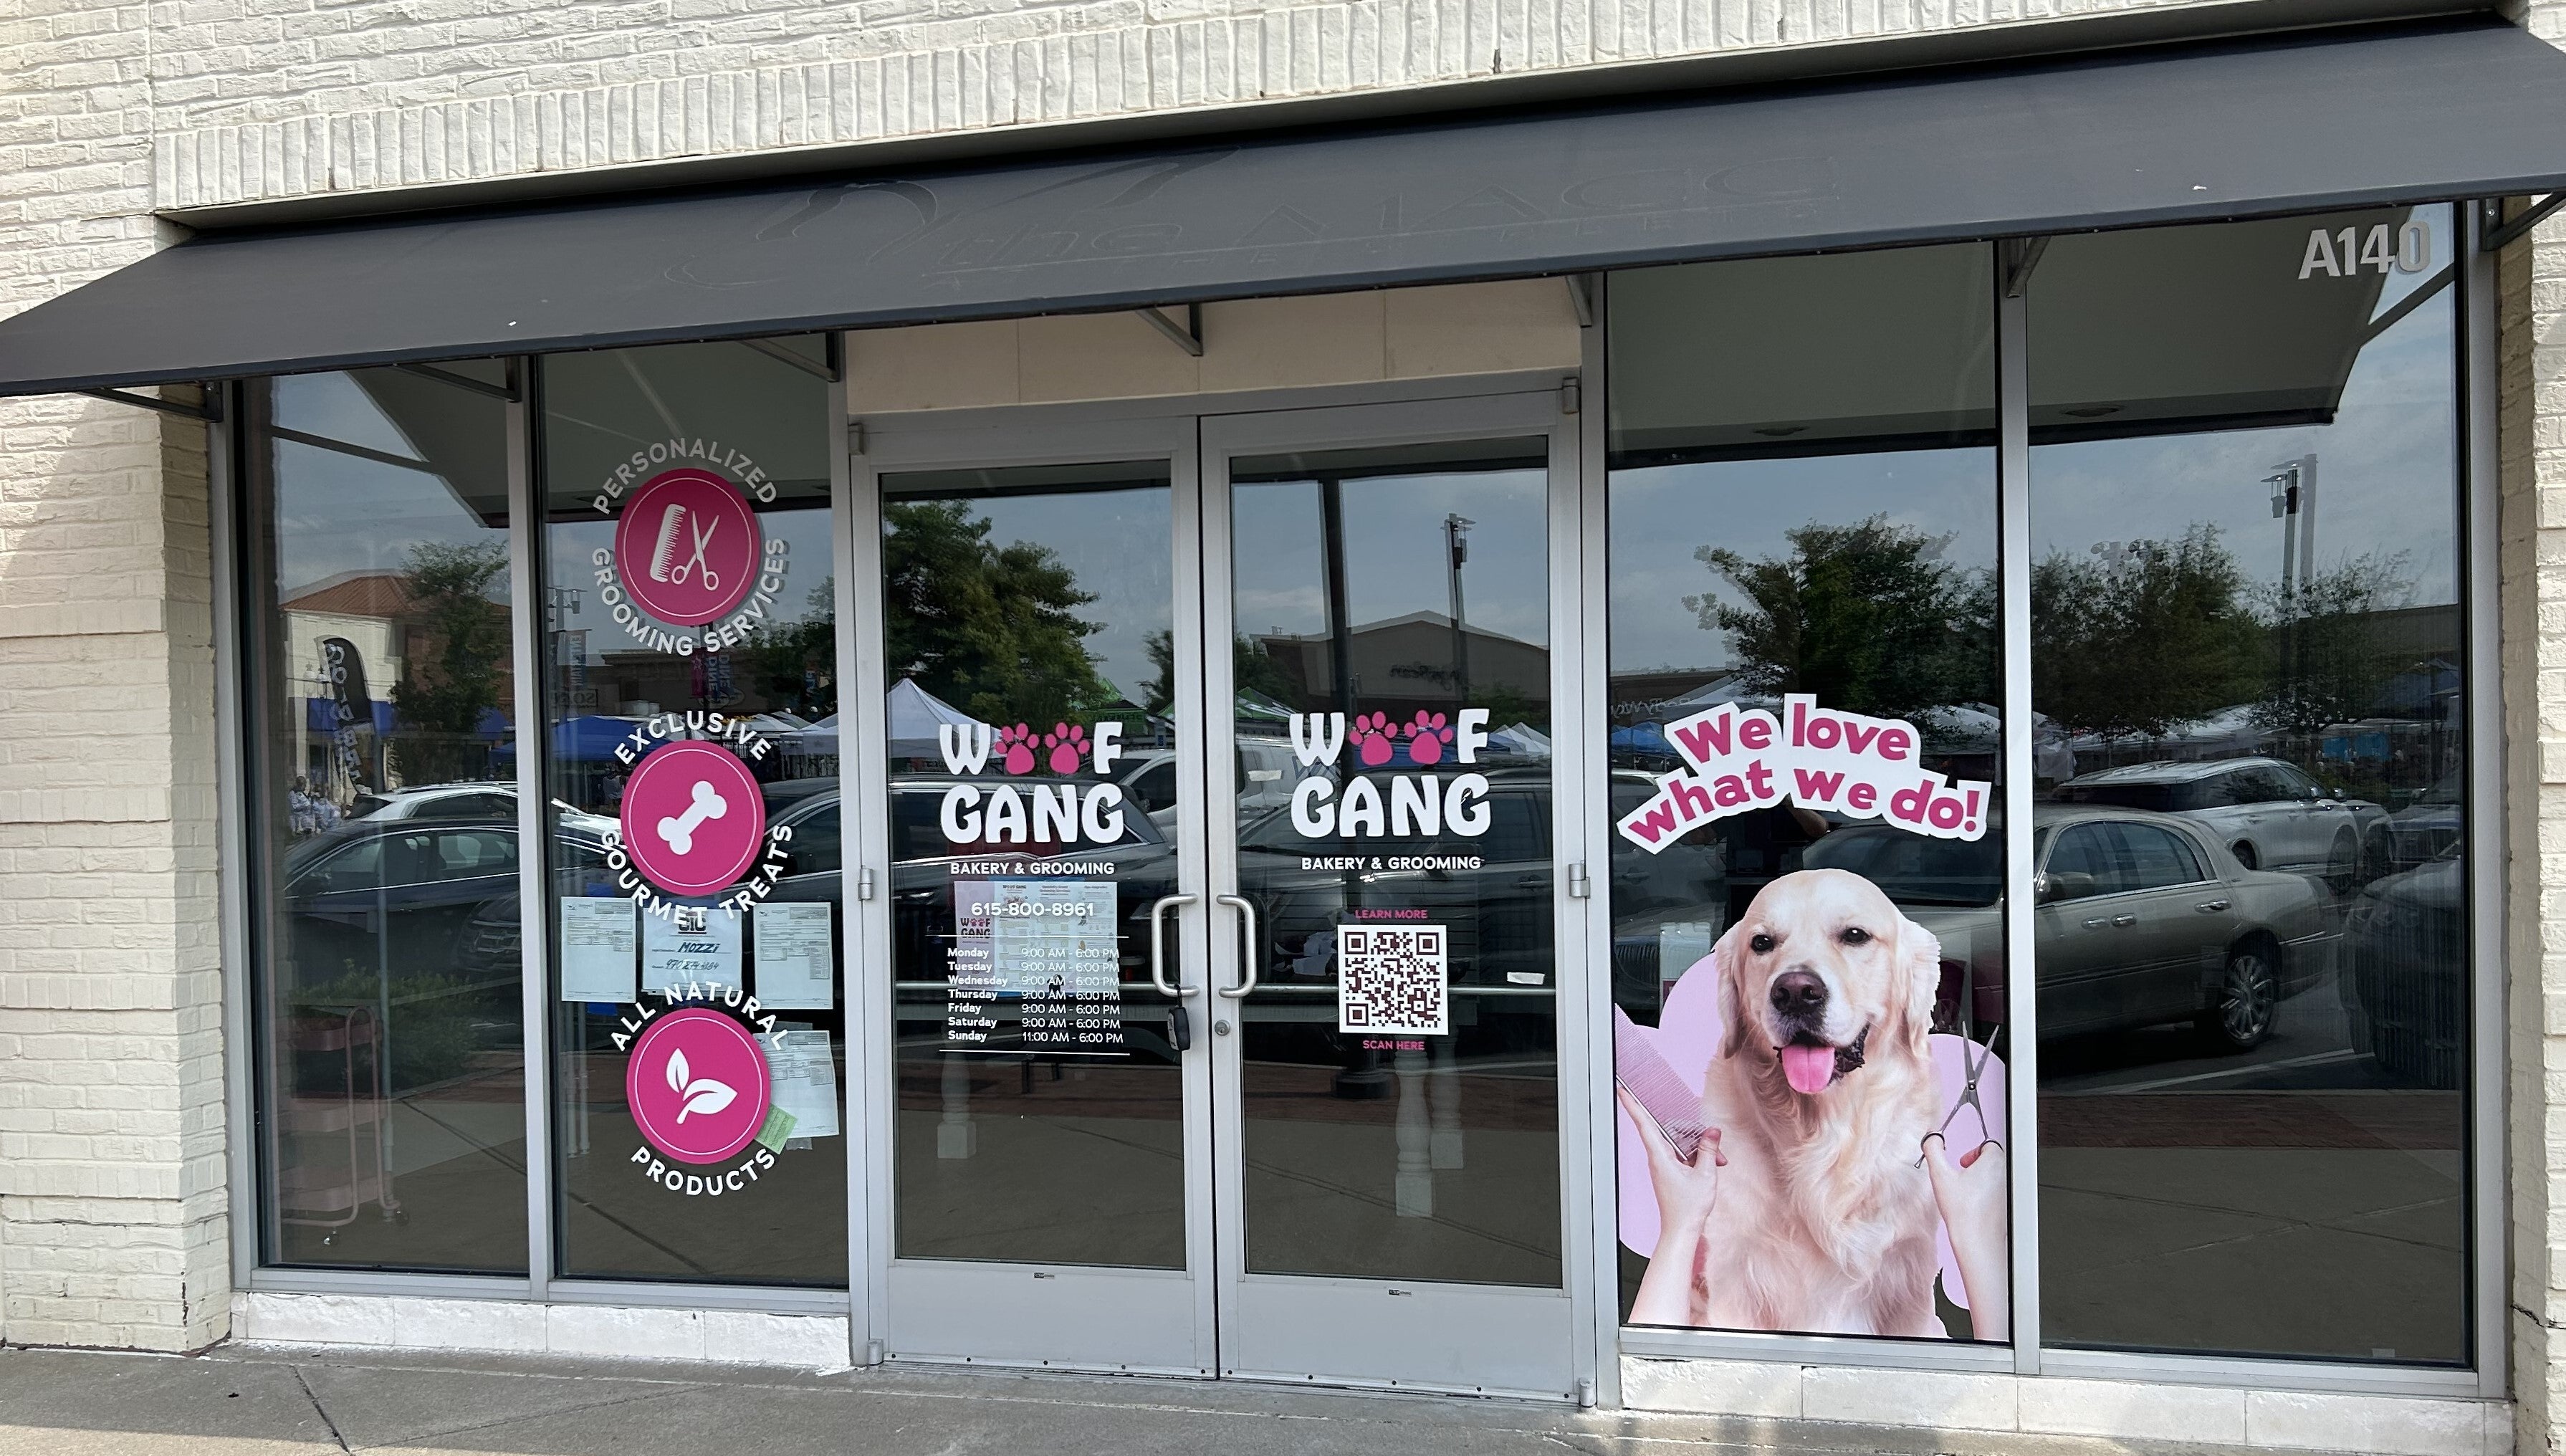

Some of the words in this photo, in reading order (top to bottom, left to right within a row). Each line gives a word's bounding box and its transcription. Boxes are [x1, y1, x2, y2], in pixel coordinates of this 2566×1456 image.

[2298, 221, 2431, 279] A140
[593, 438, 777, 514] PERSONALIZED
[592, 547, 694, 656] GROOMING
[704, 538, 785, 652] SERVICES
[614, 710, 771, 765] EXCLUSIVE
[1674, 712, 1772, 764] We
[1792, 703, 1911, 761] love
[1291, 773, 1491, 838] GANG
[1628, 759, 1775, 843] what
[1794, 768, 1877, 810] we
[1890, 779, 1980, 833] do!
[940, 783, 1124, 843] GANG
[950, 862, 1009, 875] BAKERY
[1015, 863, 1025, 874] &
[1030, 862, 1115, 875] GROOMING
[1301, 857, 1366, 870] BAKERY
[1371, 857, 1383, 869] &
[602, 829, 707, 925] GOURMET
[719, 825, 793, 920] TREATS
[971, 902, 1093, 916] 615-800-8961
[1355, 909, 1392, 919] LEARN
[1394, 909, 1429, 919] MORE
[960, 928, 991, 939] GANG
[947, 947, 990, 959] Monday
[1021, 948, 1045, 957] 9:00
[1048, 948, 1066, 957] AM
[1103, 949, 1120, 958] PM
[947, 961, 992, 973] Tuesday
[1021, 962, 1045, 971] 9:00
[1048, 962, 1066, 972] AM
[1076, 963, 1100, 972] 6:00
[1104, 963, 1120, 972] PM
[947, 975, 1008, 987] Wednesday
[1021, 976, 1045, 985] 9:00
[1048, 976, 1066, 986] AM
[1076, 977, 1100, 986] 6:00
[1104, 977, 1120, 986] PM
[947, 989, 998, 1001] Thursday
[1021, 990, 1045, 1000] 9:00
[1048, 990, 1066, 1000] AM
[1076, 991, 1100, 1000] 6:00
[1103, 991, 1120, 1000] PM
[948, 1002, 982, 1015] Friday
[1021, 1004, 1045, 1013] 9:00
[1048, 1004, 1066, 1013] AM
[1076, 1005, 1100, 1014] 6:00
[1104, 1005, 1120, 1015] PM
[611, 1002, 656, 1052] ALL
[664, 980, 789, 1051] NATURAL
[948, 1017, 997, 1029] Saturday
[1021, 1017, 1045, 1028] 9:00
[1048, 1018, 1067, 1028] AM
[1076, 1019, 1100, 1028] 6:00
[1104, 1019, 1121, 1029] PM
[948, 1030, 987, 1043] Sunday
[1023, 1032, 1048, 1041] 11:00
[1050, 1032, 1070, 1042] AM
[1079, 1033, 1103, 1043] 6:00
[1106, 1033, 1124, 1043] PM
[1363, 1040, 1393, 1050] SCAN
[1396, 1041, 1425, 1050] HERE
[631, 1146, 775, 1196] PRODUCTS
